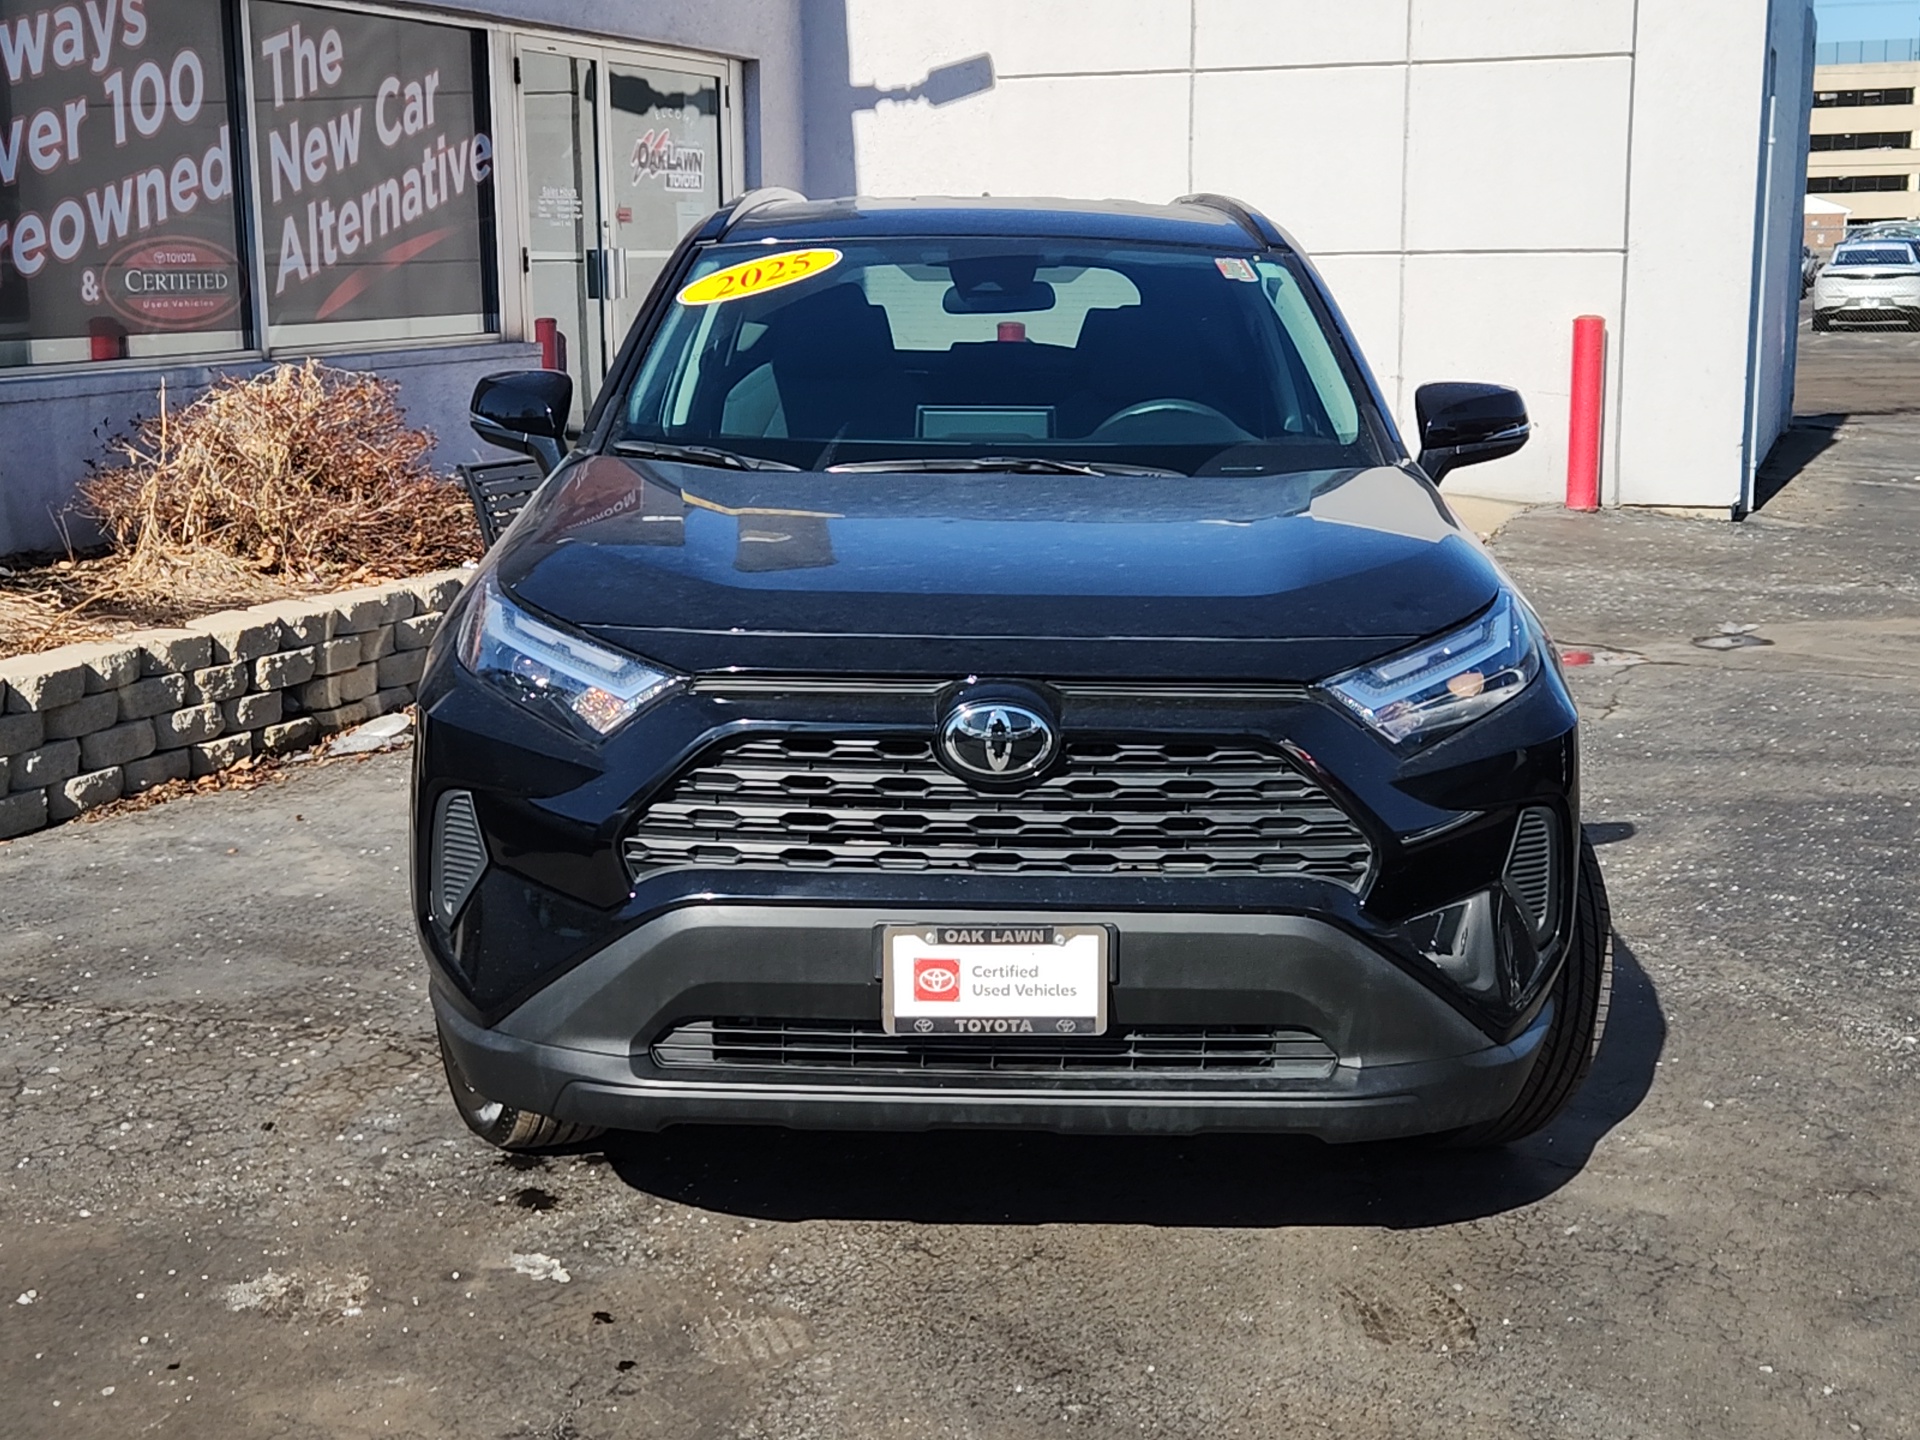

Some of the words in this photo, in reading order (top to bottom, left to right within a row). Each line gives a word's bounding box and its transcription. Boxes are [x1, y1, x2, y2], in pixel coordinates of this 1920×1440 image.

[0, 0, 147, 81] ways
[262, 25, 343, 108] The
[0, 98, 87, 183] ver
[104, 50, 203, 145] 100
[269, 107, 362, 201] New
[375, 69, 440, 146] Car
[668, 174, 701, 188] TOYOTA
[276, 133, 492, 294] Alternative
[166, 252, 197, 264] TOYOTA
[82, 270, 99, 302] &
[124, 269, 228, 292] CERTIFIED
[716, 252, 811, 298] 2025
[143, 300, 169, 309] Used
[173, 300, 215, 308] Vehicles
[945, 930, 984, 943] OAK
[991, 930, 1044, 943] LAWN
[972, 965, 1039, 978] Certified
[972, 983, 1010, 997] Used
[1014, 983, 1077, 997] Vehicles
[954, 1019, 1034, 1033] TOYOTA
